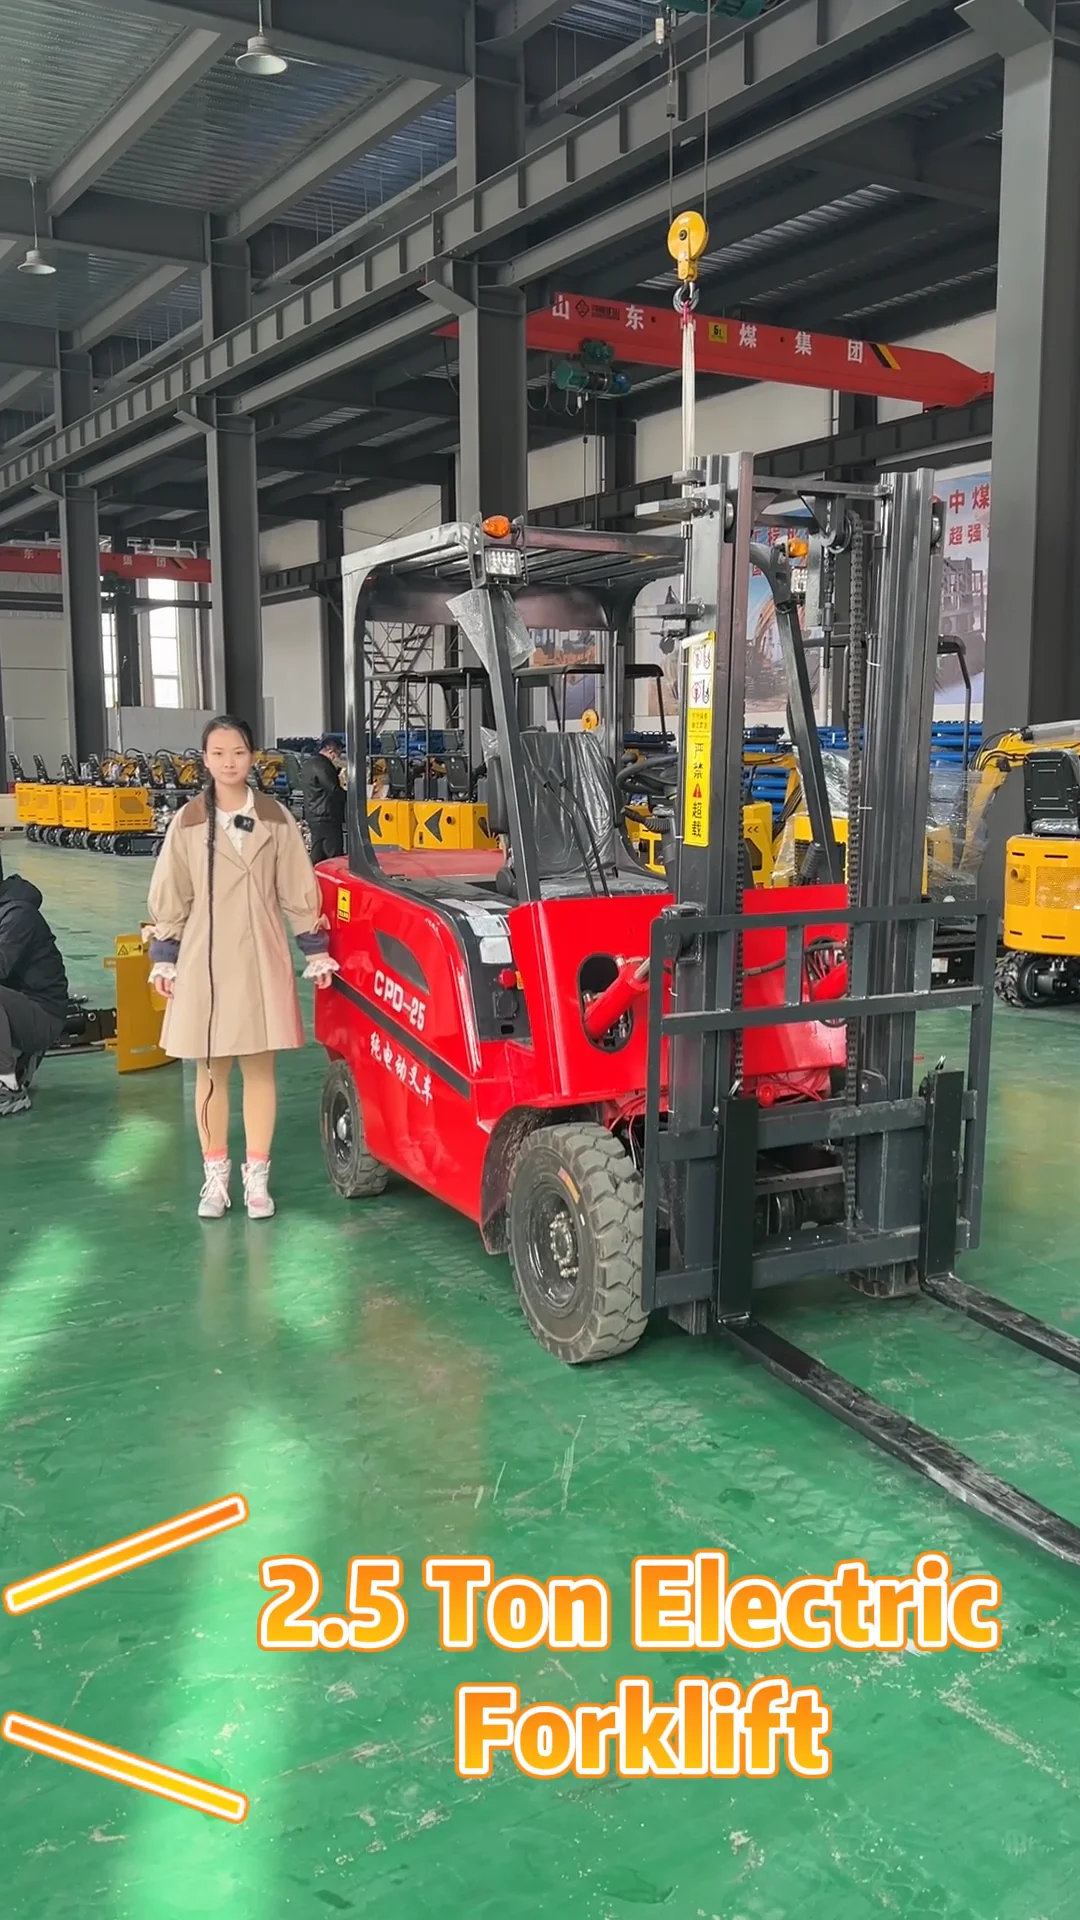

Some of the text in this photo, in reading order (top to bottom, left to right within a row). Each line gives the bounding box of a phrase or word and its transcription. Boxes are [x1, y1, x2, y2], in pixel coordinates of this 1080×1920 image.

[949, 483, 990, 514] 中煤
[949, 523, 991, 546] 超强
[374, 969, 427, 1031] CPD-25
